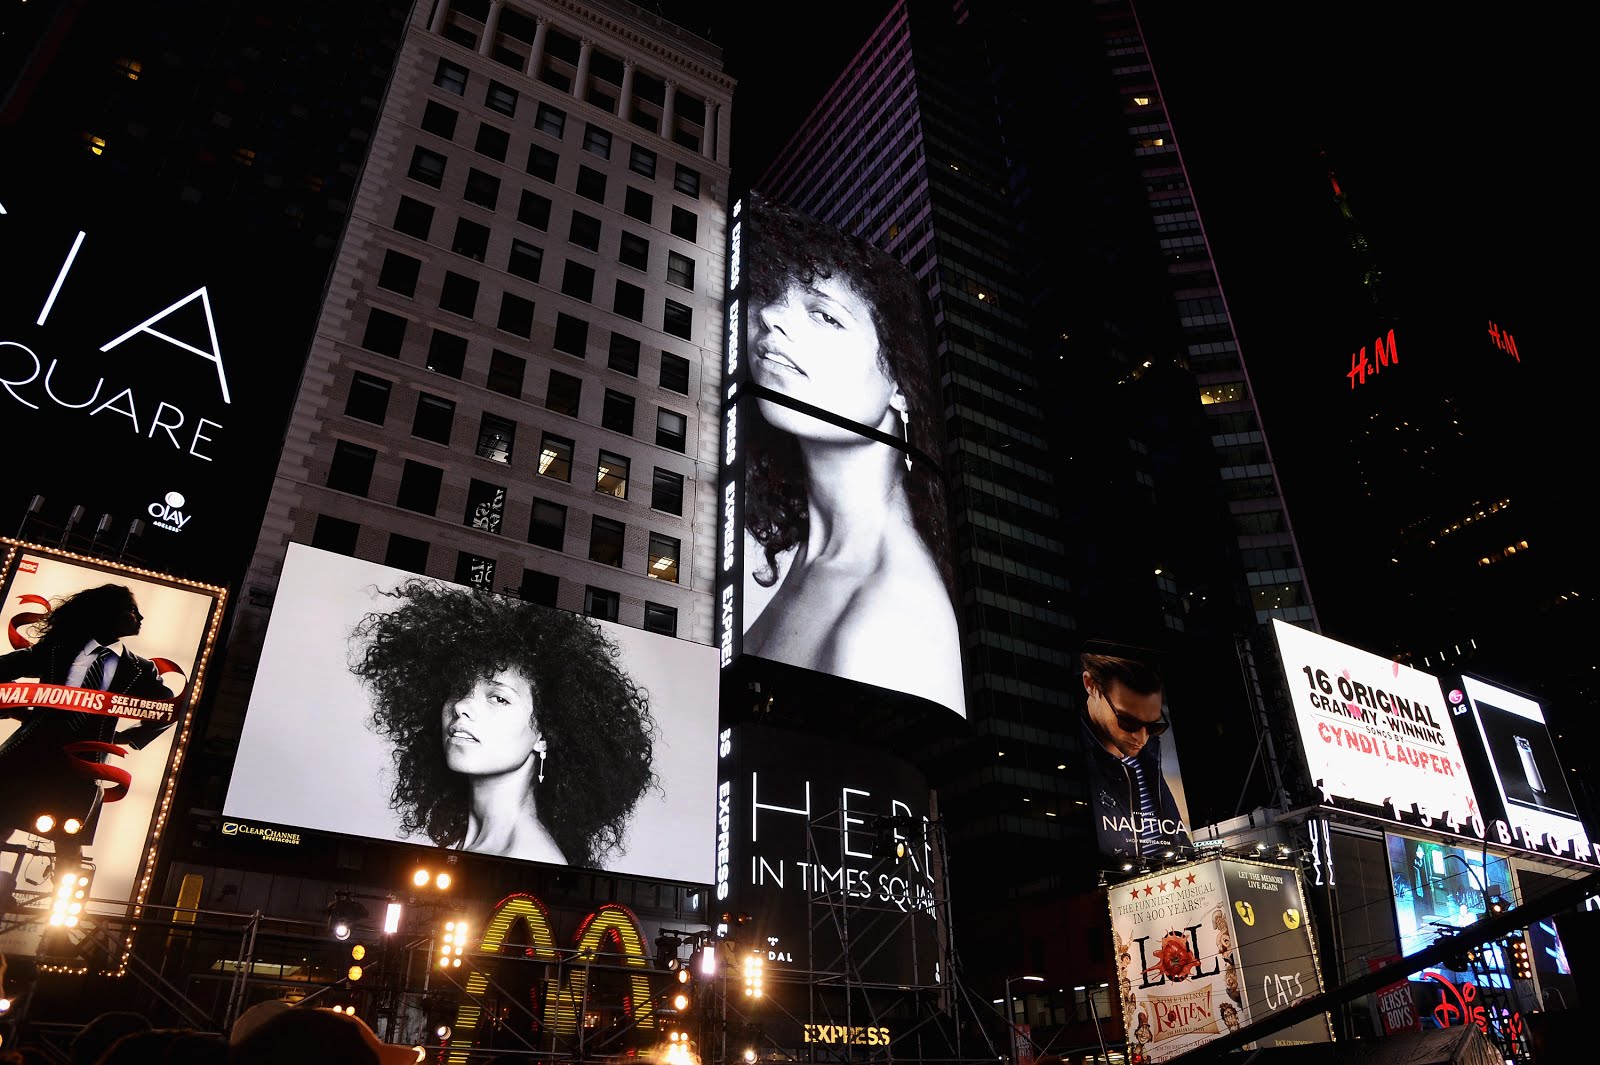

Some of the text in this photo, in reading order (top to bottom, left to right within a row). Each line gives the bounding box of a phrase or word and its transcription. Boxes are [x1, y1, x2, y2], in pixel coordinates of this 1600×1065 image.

[0, 203, 231, 404] IA
[1488, 320, 1521, 363] H&M
[1347, 329, 1399, 389] H&M
[723, 480, 736, 572] EXPRESS
[32, 687, 106, 711] MONTHS
[111, 695, 174, 713] SEE IT BEFORE
[1303, 665, 1442, 730] 16 ORIGINAL
[1453, 704, 1468, 716] LG
[108, 705, 173, 722] JANUARY 1
[1365, 726, 1405, 744] SONGS BY
[1318, 722, 1455, 777] CYNDI LAUPER
[1102, 815, 1189, 835] NAUTICA
[716, 780, 731, 901] EXPRESS
[752, 855, 784, 889] IN
[797, 861, 872, 898] TIMES
[1238, 871, 1283, 885] LET THE MEMORY
[1248, 880, 1278, 892] LIVE AGAIN
[1118, 882, 1215, 916] THE FUNNIEST MUSICAL
[1133, 912, 1144, 925] IN
[1146, 908, 1165, 922] 400
[1263, 971, 1304, 1011] CATS
[1380, 984, 1413, 1013] JERSEY
[1387, 1006, 1414, 1030] BOYS
[803, 1023, 890, 1047] EXPRESS
